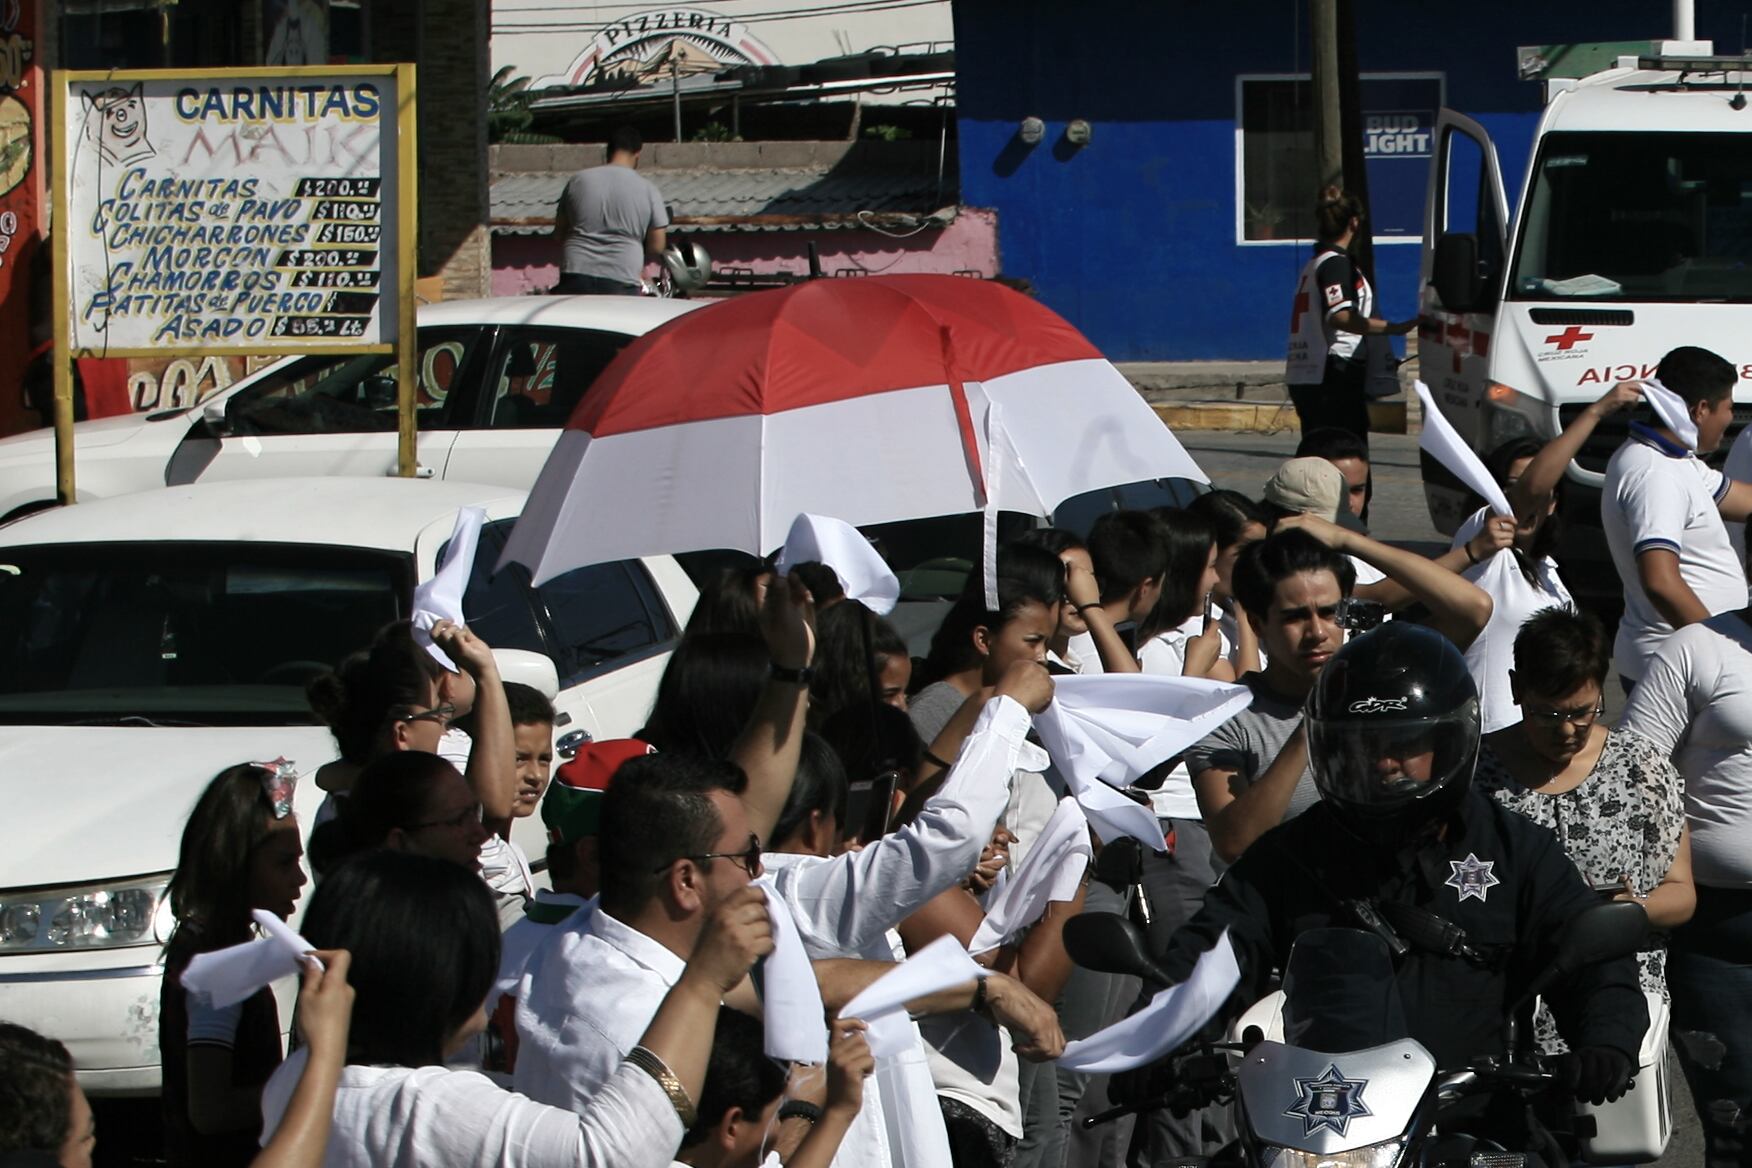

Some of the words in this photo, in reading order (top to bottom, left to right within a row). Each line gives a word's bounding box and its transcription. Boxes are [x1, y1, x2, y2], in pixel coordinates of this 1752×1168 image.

[605, 12, 732, 45] PIZZERIA
[174, 83, 380, 123] CARNITAS
[1366, 116, 1419, 134] BUD
[1364, 134, 1429, 153] IGHT
[119, 168, 260, 199] CARNITAS
[91, 199, 205, 236] COLITAS
[235, 200, 302, 222] PAVO
[109, 223, 309, 249] CHICHARRONES
[141, 246, 272, 270] MORCON
[108, 262, 282, 293] CHAMORROS
[85, 292, 205, 320] PATITAS
[230, 292, 322, 314] PUERCO
[155, 315, 266, 341] ASADO
